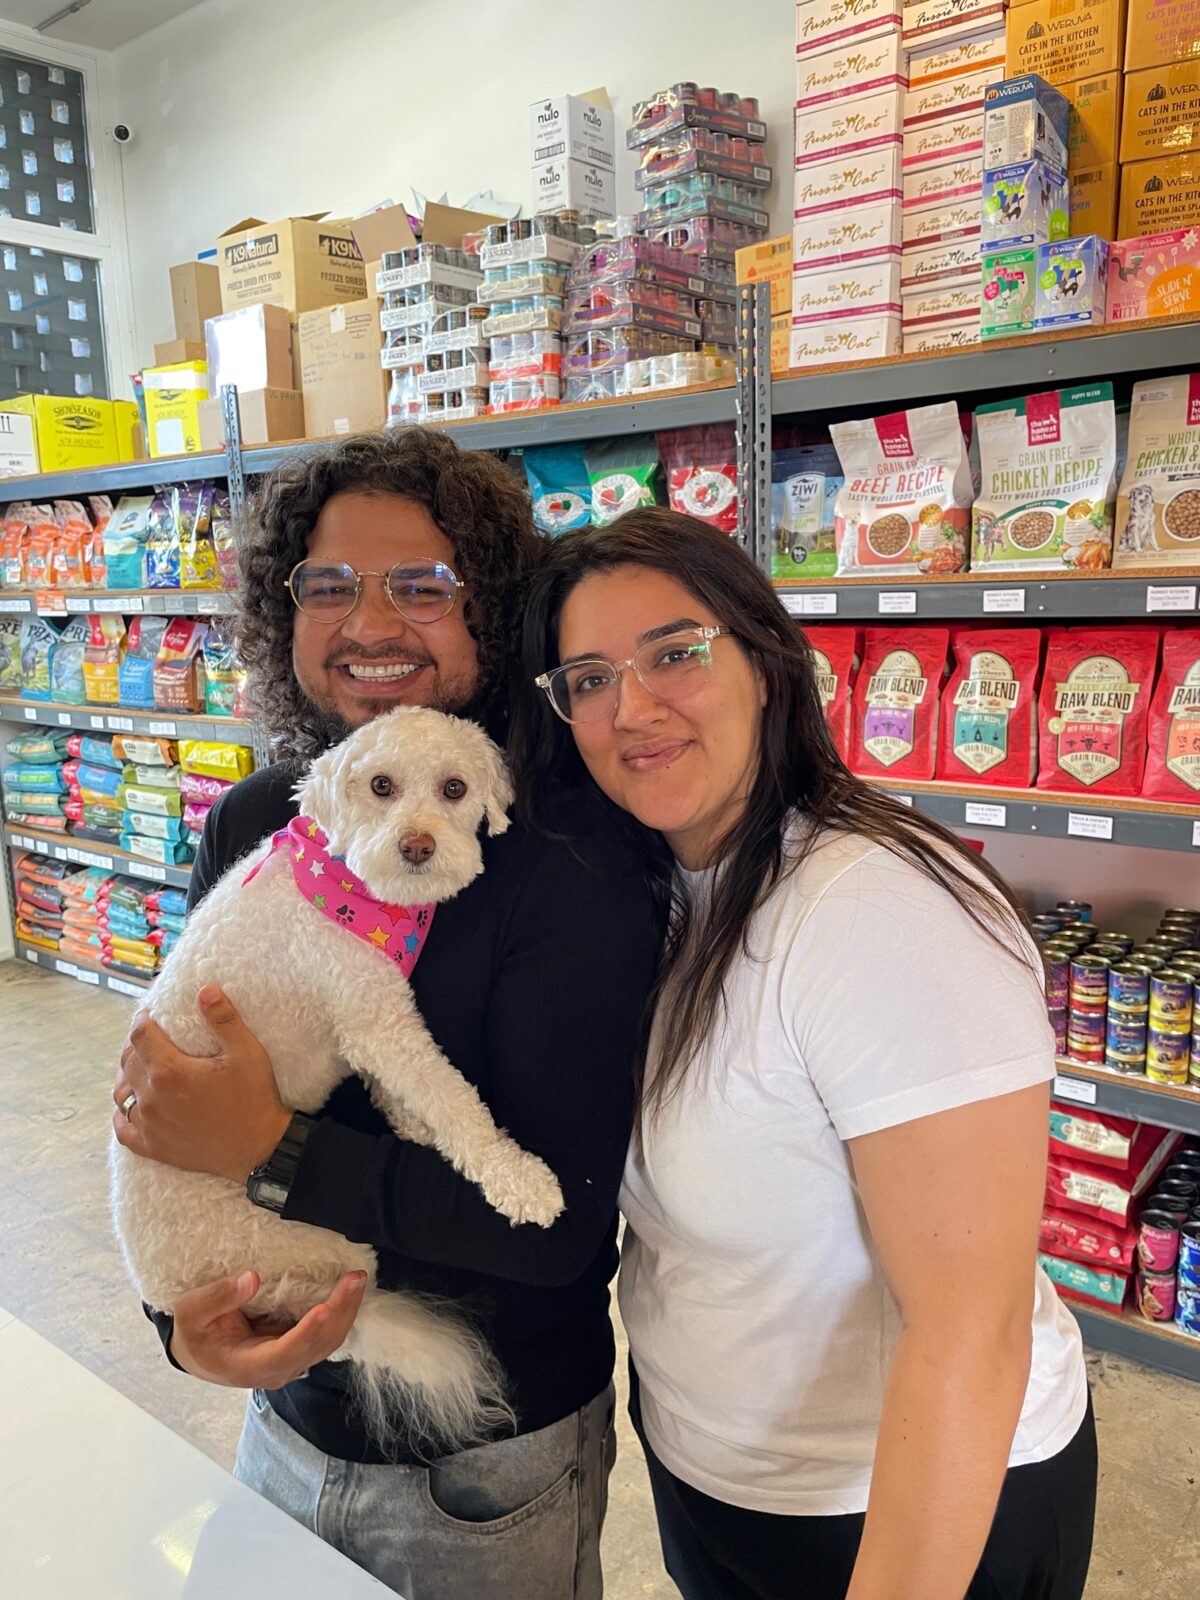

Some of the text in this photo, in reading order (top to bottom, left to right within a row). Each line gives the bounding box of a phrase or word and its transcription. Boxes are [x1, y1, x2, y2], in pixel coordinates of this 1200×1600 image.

[802, 11, 846, 36] Fussie
[916, 8, 953, 28] Fussie
[1047, 12, 1093, 32] WERUVA
[1019, 25, 1099, 56] CATS IN THE KITCHEN
[923, 43, 994, 73] Fussie Cat
[1034, 55, 1041, 63] BY
[1043, 50, 1061, 60] LAND,
[1075, 43, 1083, 52] BY
[1084, 40, 1096, 49] SEA
[804, 53, 889, 92] Fussie Cat
[917, 85, 985, 113] Fussie Cat
[999, 82, 1034, 97] WERUVA
[537, 109, 559, 123] nulo
[583, 112, 602, 126] nulo
[1138, 106, 1157, 118] CATS
[1160, 104, 1169, 114] IN
[1172, 100, 1186, 111] THE
[1153, 117, 1169, 126] LOVE
[1171, 114, 1180, 122] ME
[803, 114, 888, 149] Fussie Cat
[917, 135, 955, 153] Fussie
[540, 172, 560, 186] nulo
[585, 175, 603, 187] nulo
[801, 169, 885, 202] Fussie Cat
[919, 179, 955, 196] Fussie
[1135, 197, 1153, 208] CATS
[1156, 195, 1165, 205] IN
[1168, 193, 1182, 203] THE
[1140, 208, 1169, 218] PUMPKIN
[916, 219, 953, 236] Fussie
[800, 225, 884, 256] Fussie Cat
[914, 259, 951, 277] Fussie
[799, 284, 883, 311] Fussie Cat
[1156, 279, 1182, 298] SLIDE
[1163, 288, 1192, 308] SERVE
[916, 300, 952, 316] Fussie
[1112, 304, 1140, 320] KITTY
[796, 335, 880, 360] Fussie Cat
[1018, 446, 1073, 467] GRAIN FREE
[1136, 444, 1199, 470] CHICKEN &
[877, 461, 905, 475] GRAIN
[992, 457, 1104, 494] CHICKEN RECIPE
[1134, 467, 1158, 478] TASTY
[1160, 463, 1188, 473] WHOLE
[791, 483, 818, 496] ZIWI
[850, 465, 945, 495] BEEF RECIPE
[1014, 490, 1038, 500] WHOLE
[1063, 478, 1099, 494] CLUSTERS
[869, 677, 925, 697] RAW BLEND
[979, 681, 1017, 701] BLEND
[1059, 692, 1131, 711] RAW BLEND
